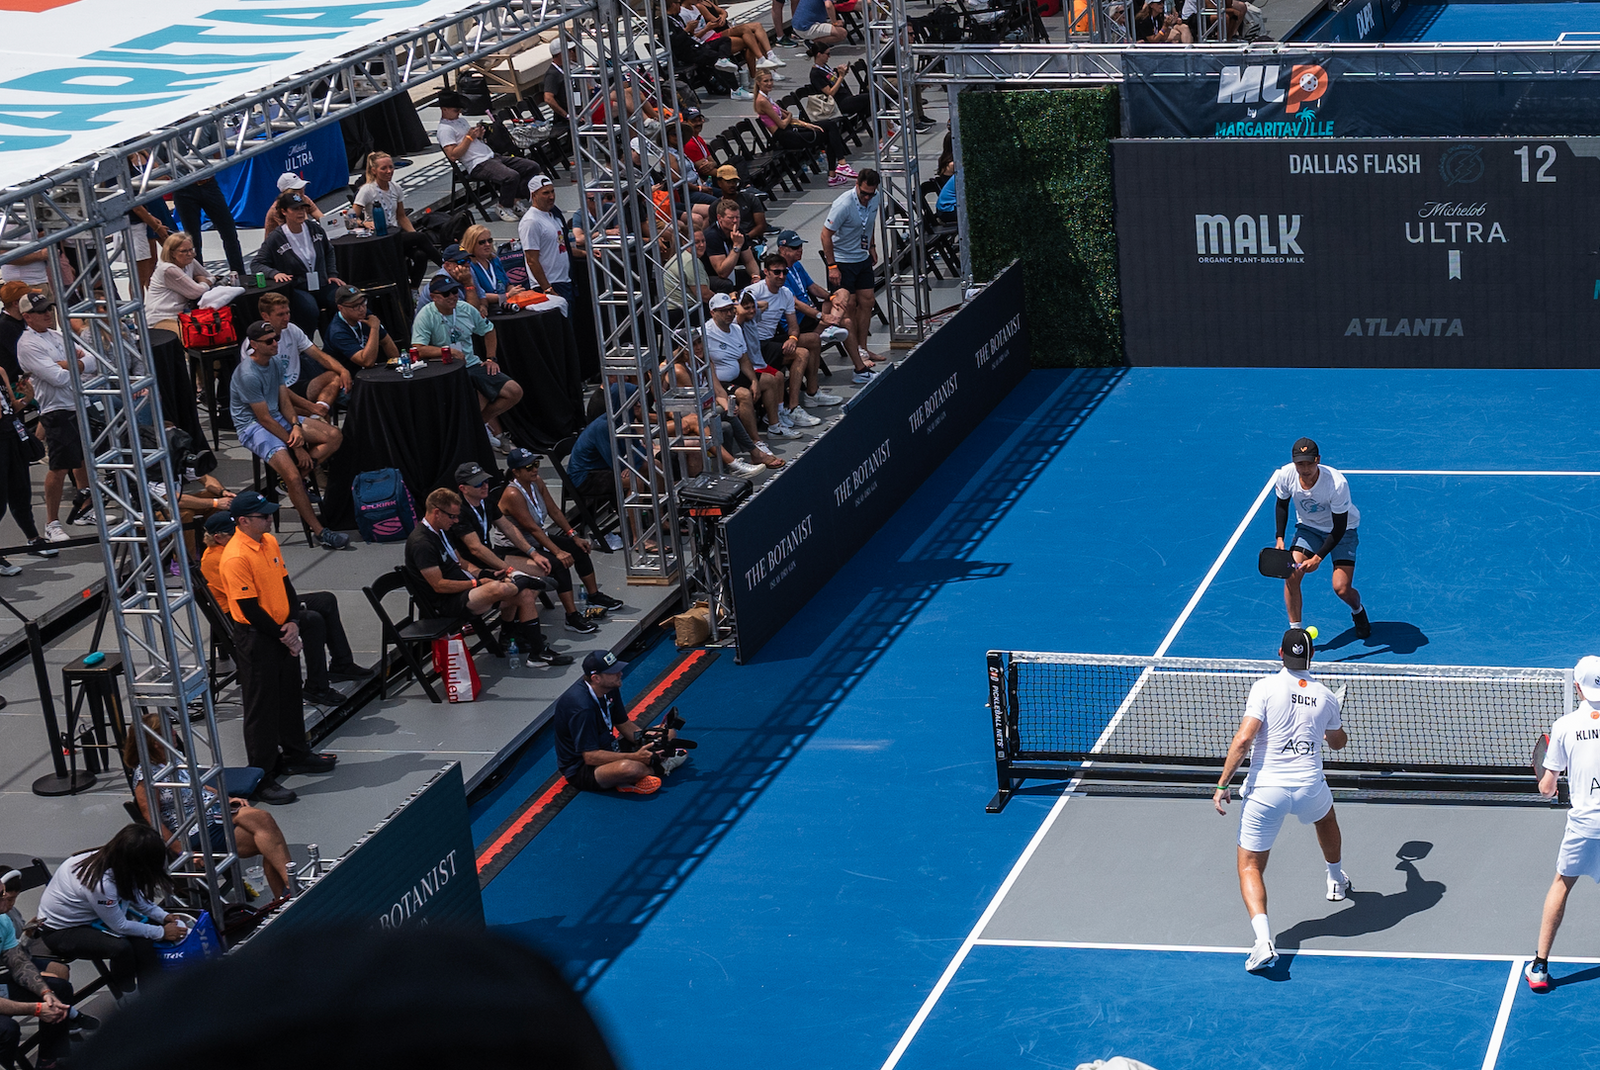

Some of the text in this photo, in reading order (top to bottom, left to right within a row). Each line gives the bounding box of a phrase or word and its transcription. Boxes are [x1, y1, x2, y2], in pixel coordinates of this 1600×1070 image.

[0, 0, 430, 152] ARITA
[1217, 64, 1329, 113] MLP
[1247, 107, 1257, 119] by
[284, 151, 314, 172] ULTRA
[1289, 154, 1359, 174] DALLAS
[1364, 154, 1421, 174] FLASH
[1513, 145, 1557, 183] 12
[1418, 201, 1488, 218] Michelob
[1195, 214, 1305, 255] MALK
[1405, 222, 1508, 243] ULTRA
[1344, 318, 1464, 337] ATLANTA
[975, 341, 991, 369] THE
[989, 313, 1022, 356] BOTANIST
[908, 405, 925, 433] THE
[923, 372, 958, 419] BOTANIST
[834, 438, 892, 507] THE BOTANIST
[744, 514, 813, 591] THE BOTANIST
[1291, 693, 1317, 708] SOCK
[996, 728, 1004, 749] NETS
[1281, 738, 1315, 756] AG1
